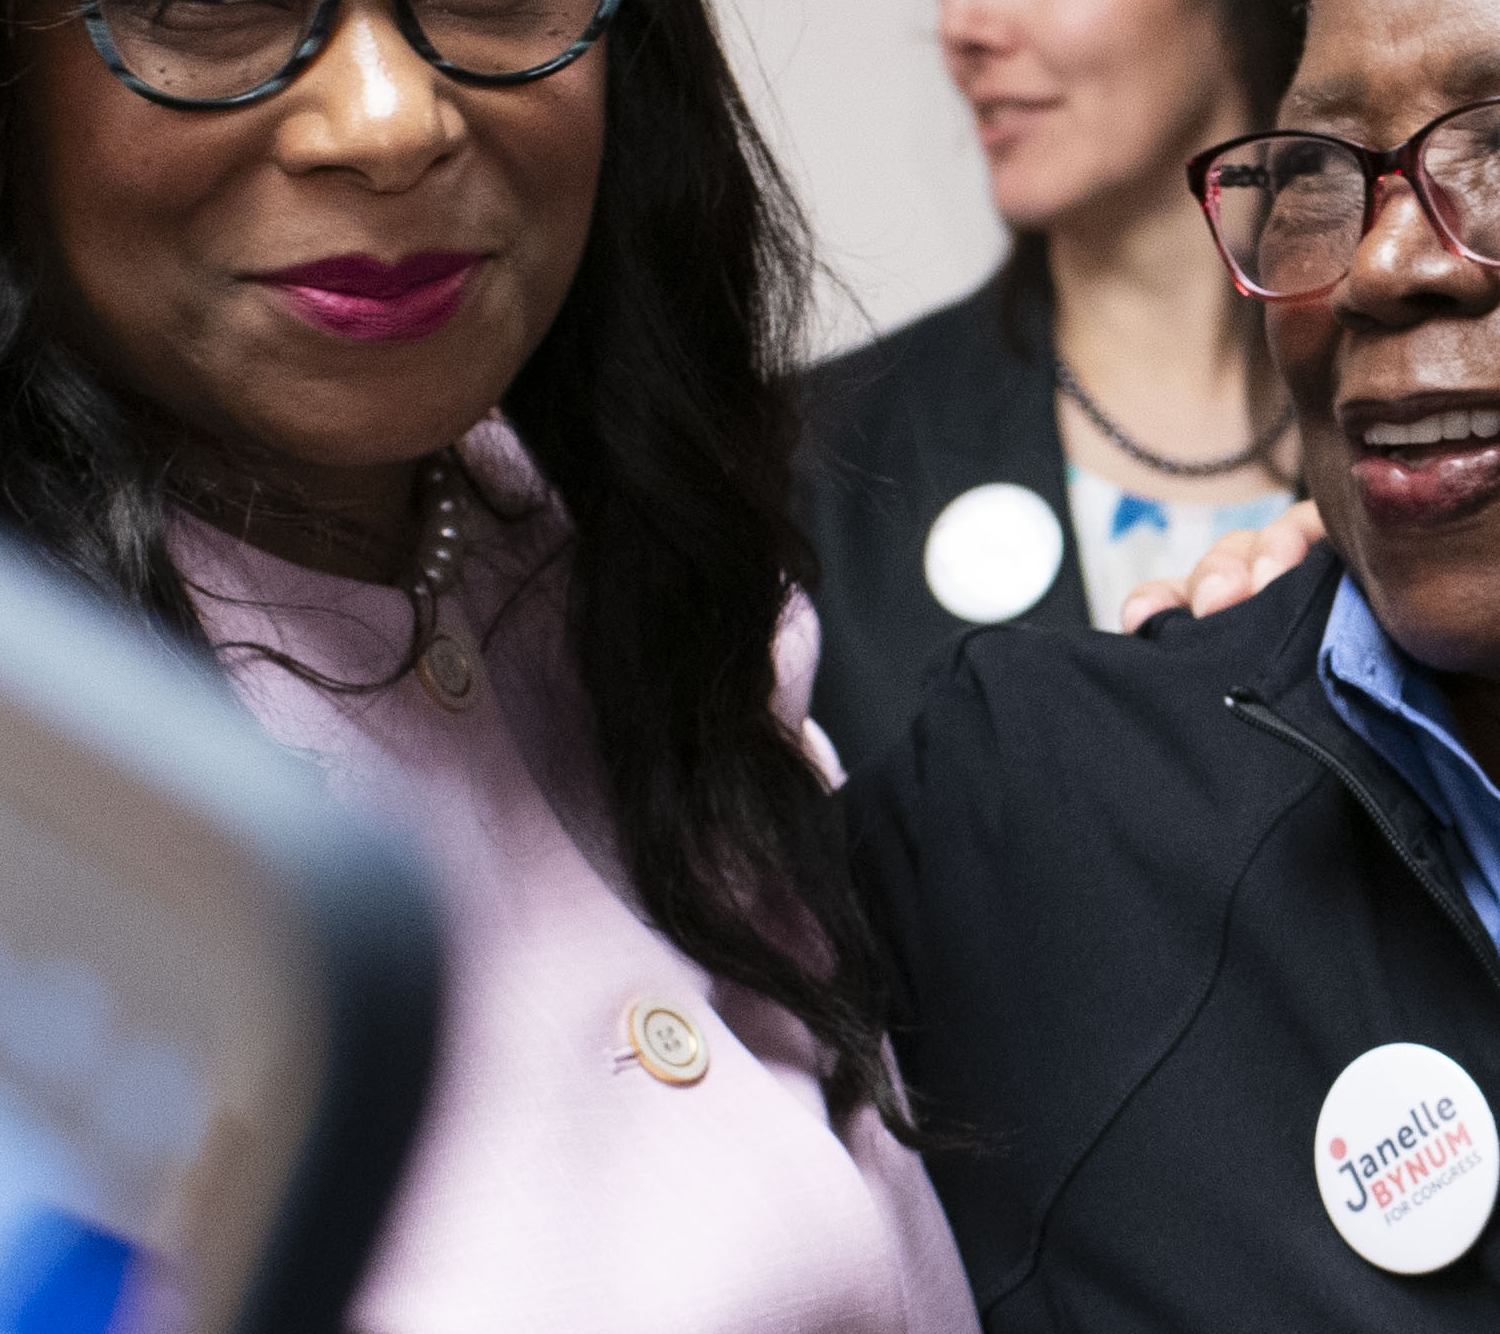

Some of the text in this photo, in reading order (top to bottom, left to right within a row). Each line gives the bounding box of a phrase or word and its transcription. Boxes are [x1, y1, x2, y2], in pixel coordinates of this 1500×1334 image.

[1371, 1122, 1473, 1209] BYNUM
[1383, 1149, 1483, 1228] FOR CONGRESS
